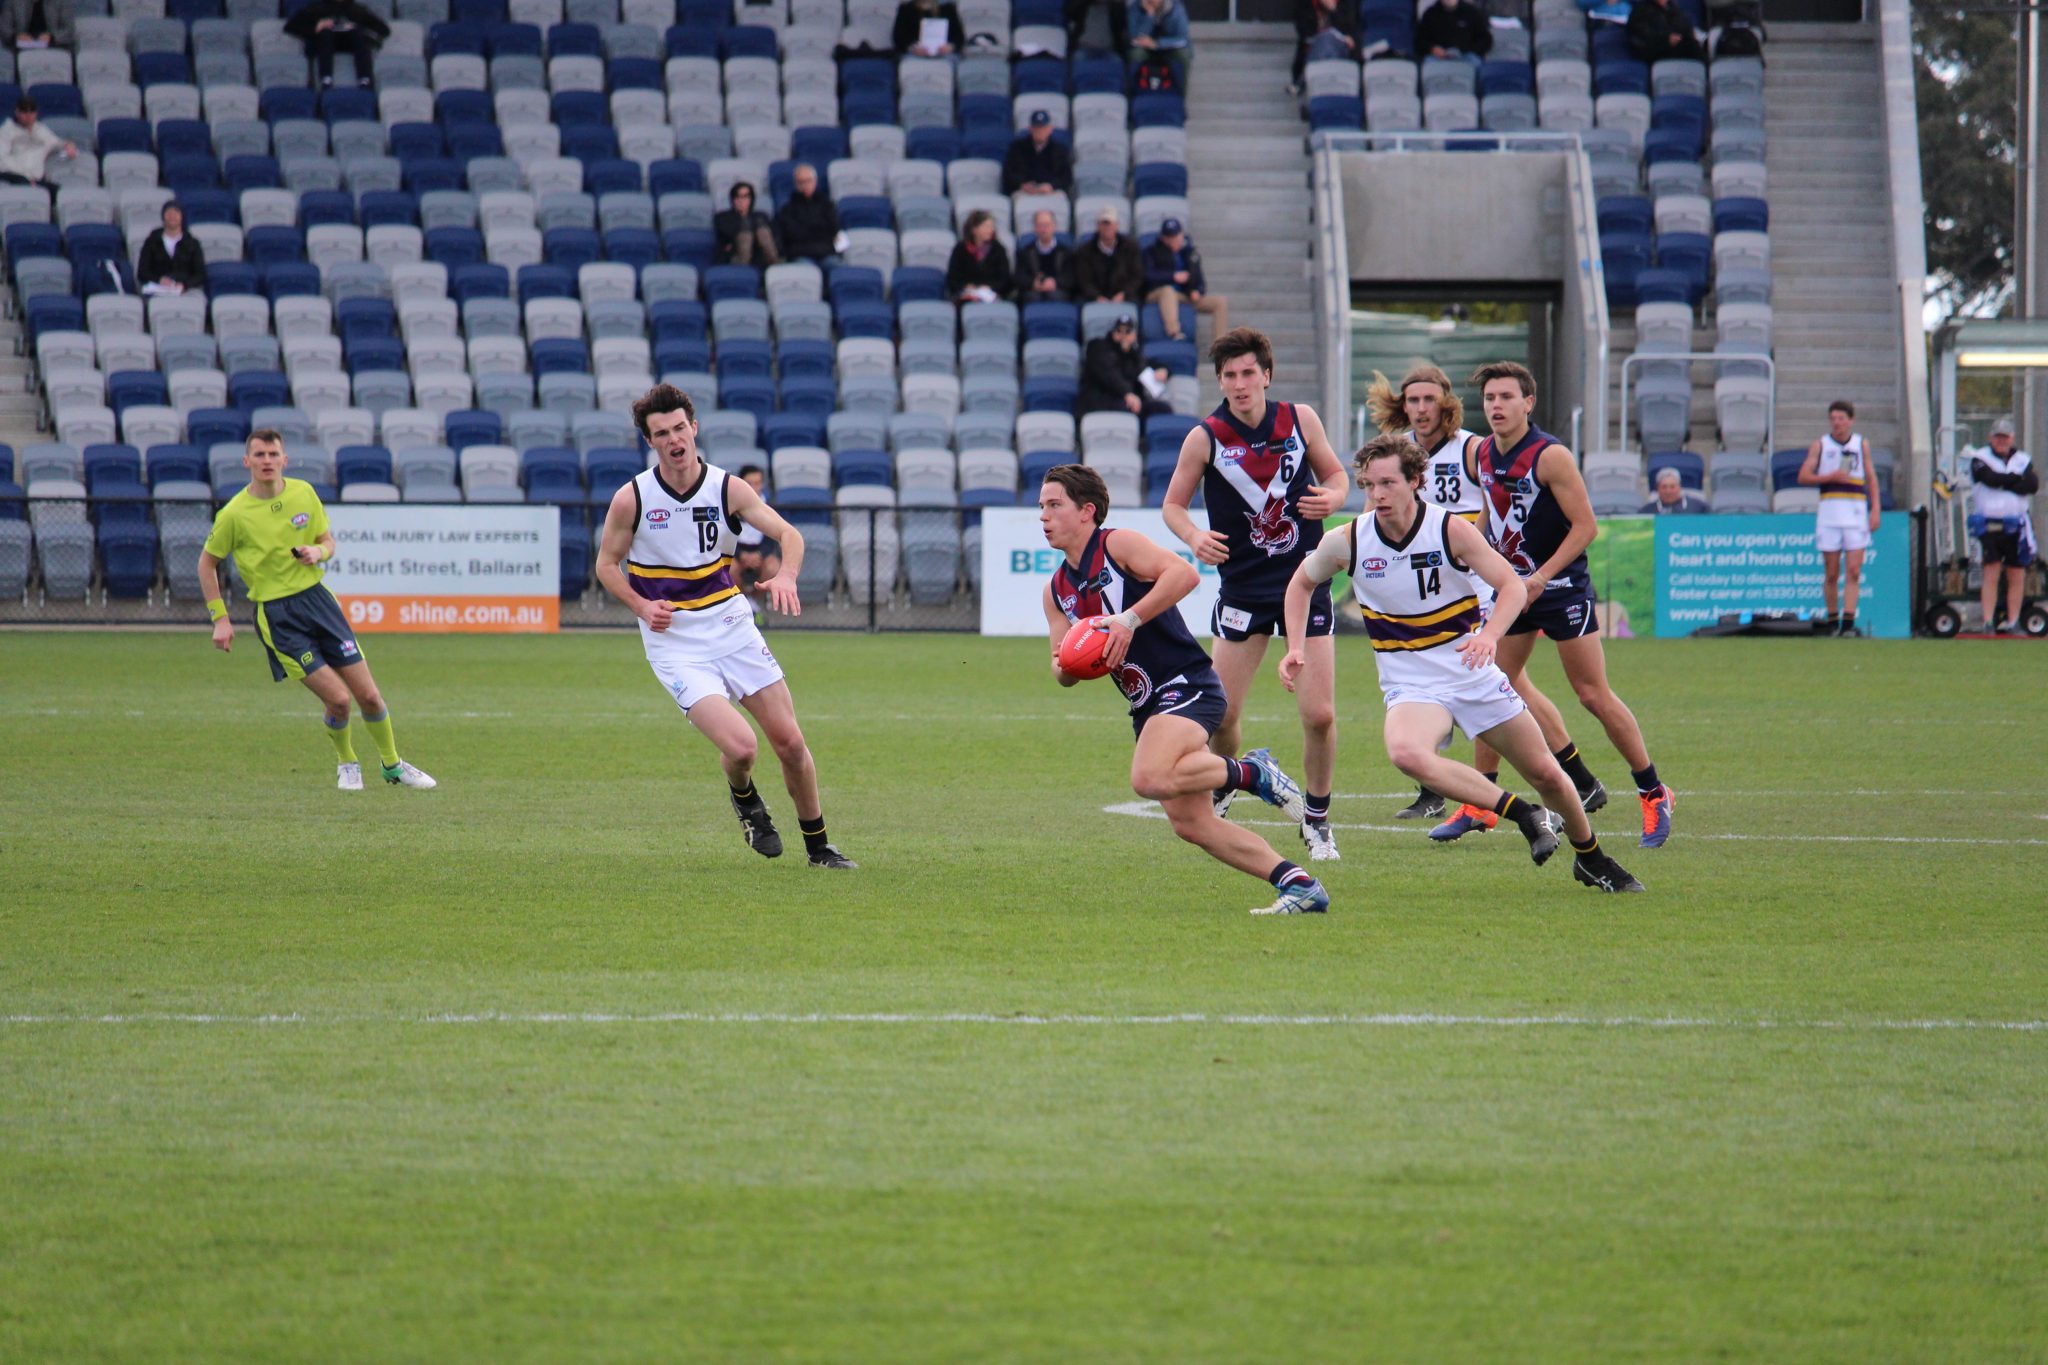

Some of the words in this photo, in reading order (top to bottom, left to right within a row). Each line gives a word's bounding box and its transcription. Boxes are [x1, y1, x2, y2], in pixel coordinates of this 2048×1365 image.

[1222, 448, 1246, 458] AFL
[1280, 454, 1294, 483] 6
[1435, 476, 1461, 504] 33
[647, 511, 669, 521] AFL
[1511, 494, 1528, 523] 5
[382, 530, 433, 543] INJURY
[439, 530, 470, 543] LAW
[475, 530, 540, 543] EXPERTS
[697, 521, 719, 553] 19
[1669, 533, 1700, 548] Can
[1703, 534, 1733, 550] you
[1735, 534, 1776, 550] open
[1779, 534, 1815, 550] your
[1363, 559, 1386, 570] AFL
[1669, 551, 1712, 567] heart
[1715, 551, 1746, 566] and
[1748, 551, 1794, 566] home
[1797, 552, 1814, 566] to
[348, 558, 393, 575] Sturt
[400, 558, 462, 577] Street,
[469, 558, 542, 575] Ballarat
[1366, 571, 1385, 579] VICTORIA
[1417, 567, 1441, 600] 14
[1669, 573, 1693, 586] Call
[1695, 573, 1729, 588] today
[1731, 574, 1745, 586] to
[1747, 573, 1793, 586] discuss
[1669, 587, 1709, 600] foster
[1710, 589, 1744, 600] carer
[1062, 595, 1077, 609] AFL
[349, 600, 384, 624] 99
[400, 600, 543, 625] shine.com.au
[1074, 627, 1095, 651] TOWARDS
